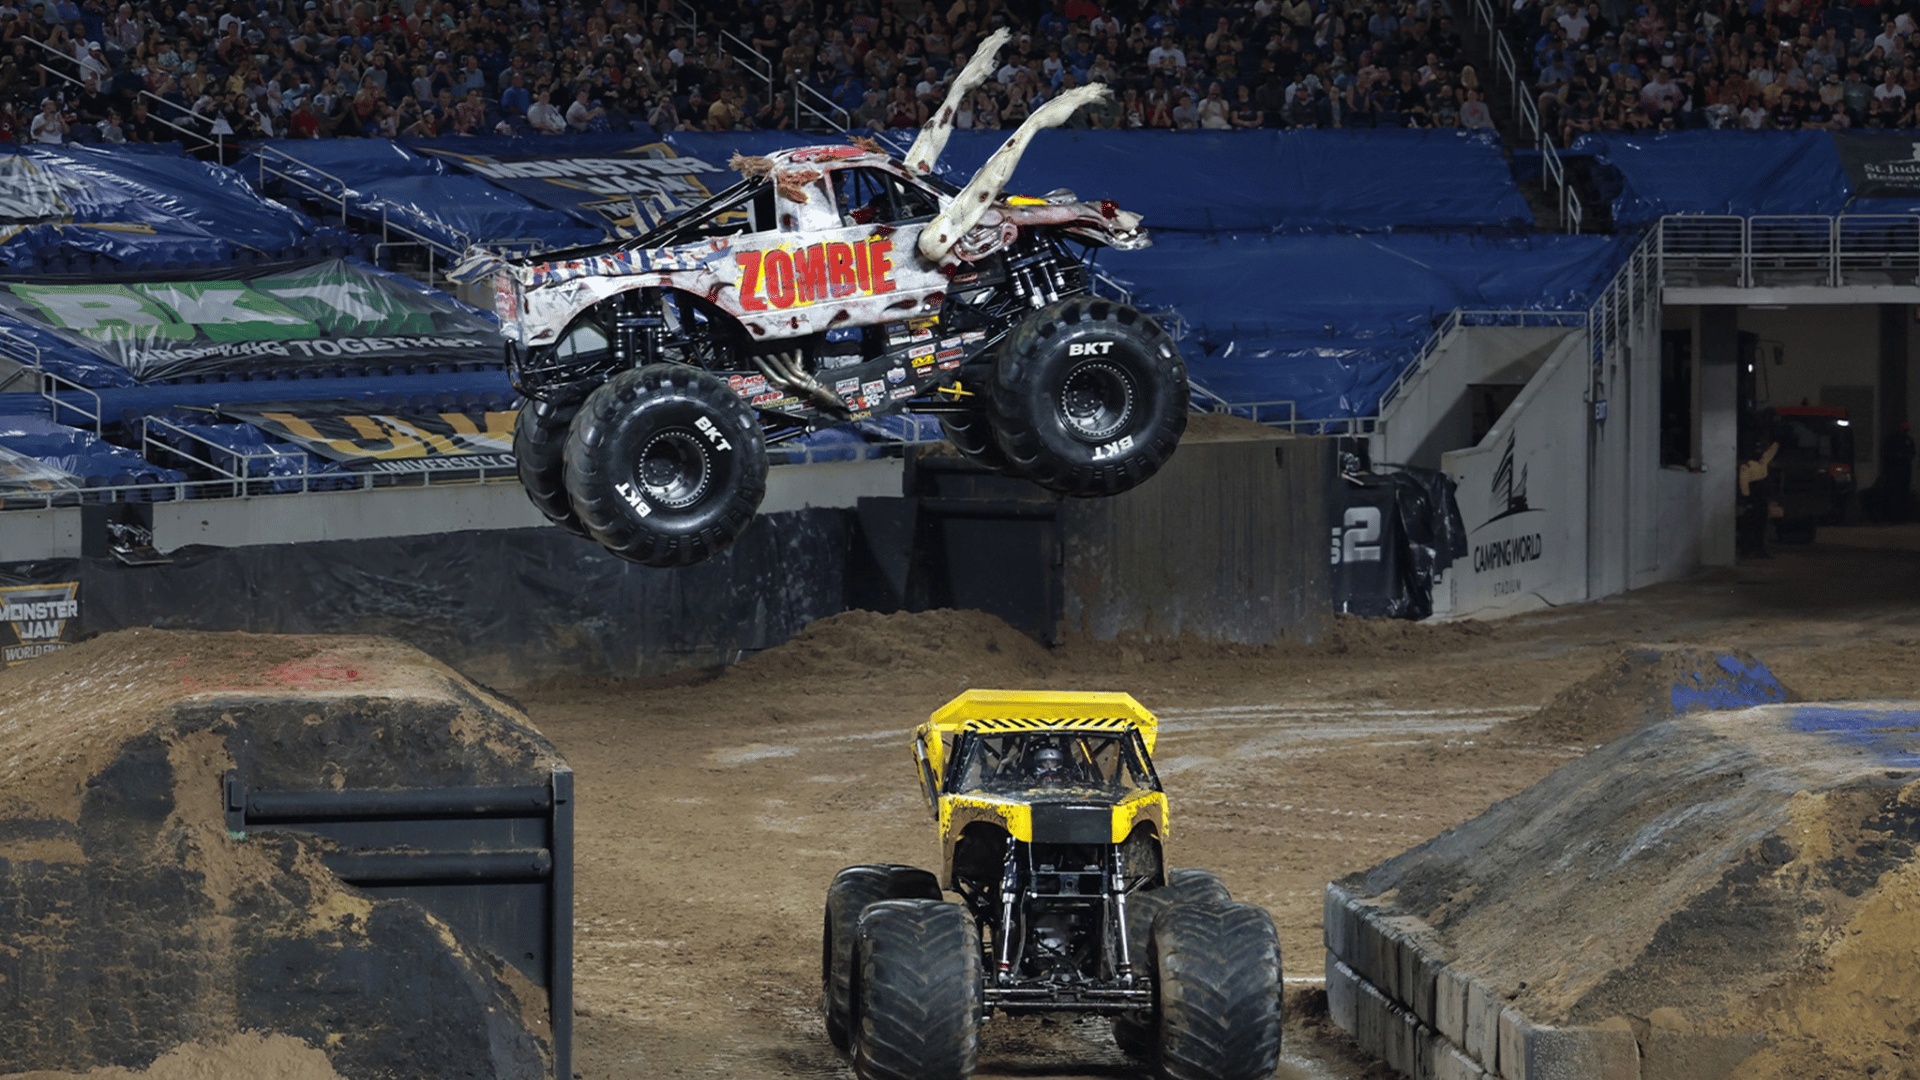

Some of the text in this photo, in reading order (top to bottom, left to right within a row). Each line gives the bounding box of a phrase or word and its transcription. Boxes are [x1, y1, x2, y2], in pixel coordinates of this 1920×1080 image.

[462, 156, 724, 178] MONSTER
[587, 174, 700, 194] JAM
[735, 239, 896, 311] ZOMBIE
[1068, 341, 1114, 357] BKT
[694, 416, 732, 451] BKT
[1092, 435, 1135, 460] BKT
[373, 455, 499, 472] UNIVERSITY
[614, 482, 652, 518] BKT
[1474, 533, 1542, 573] CAMPING WORLD
[1493, 579, 1522, 597] STADIUM
[0, 600, 78, 621] MONSTER
[21, 620, 59, 639] JAM
[5, 645, 42, 661] WORLD
